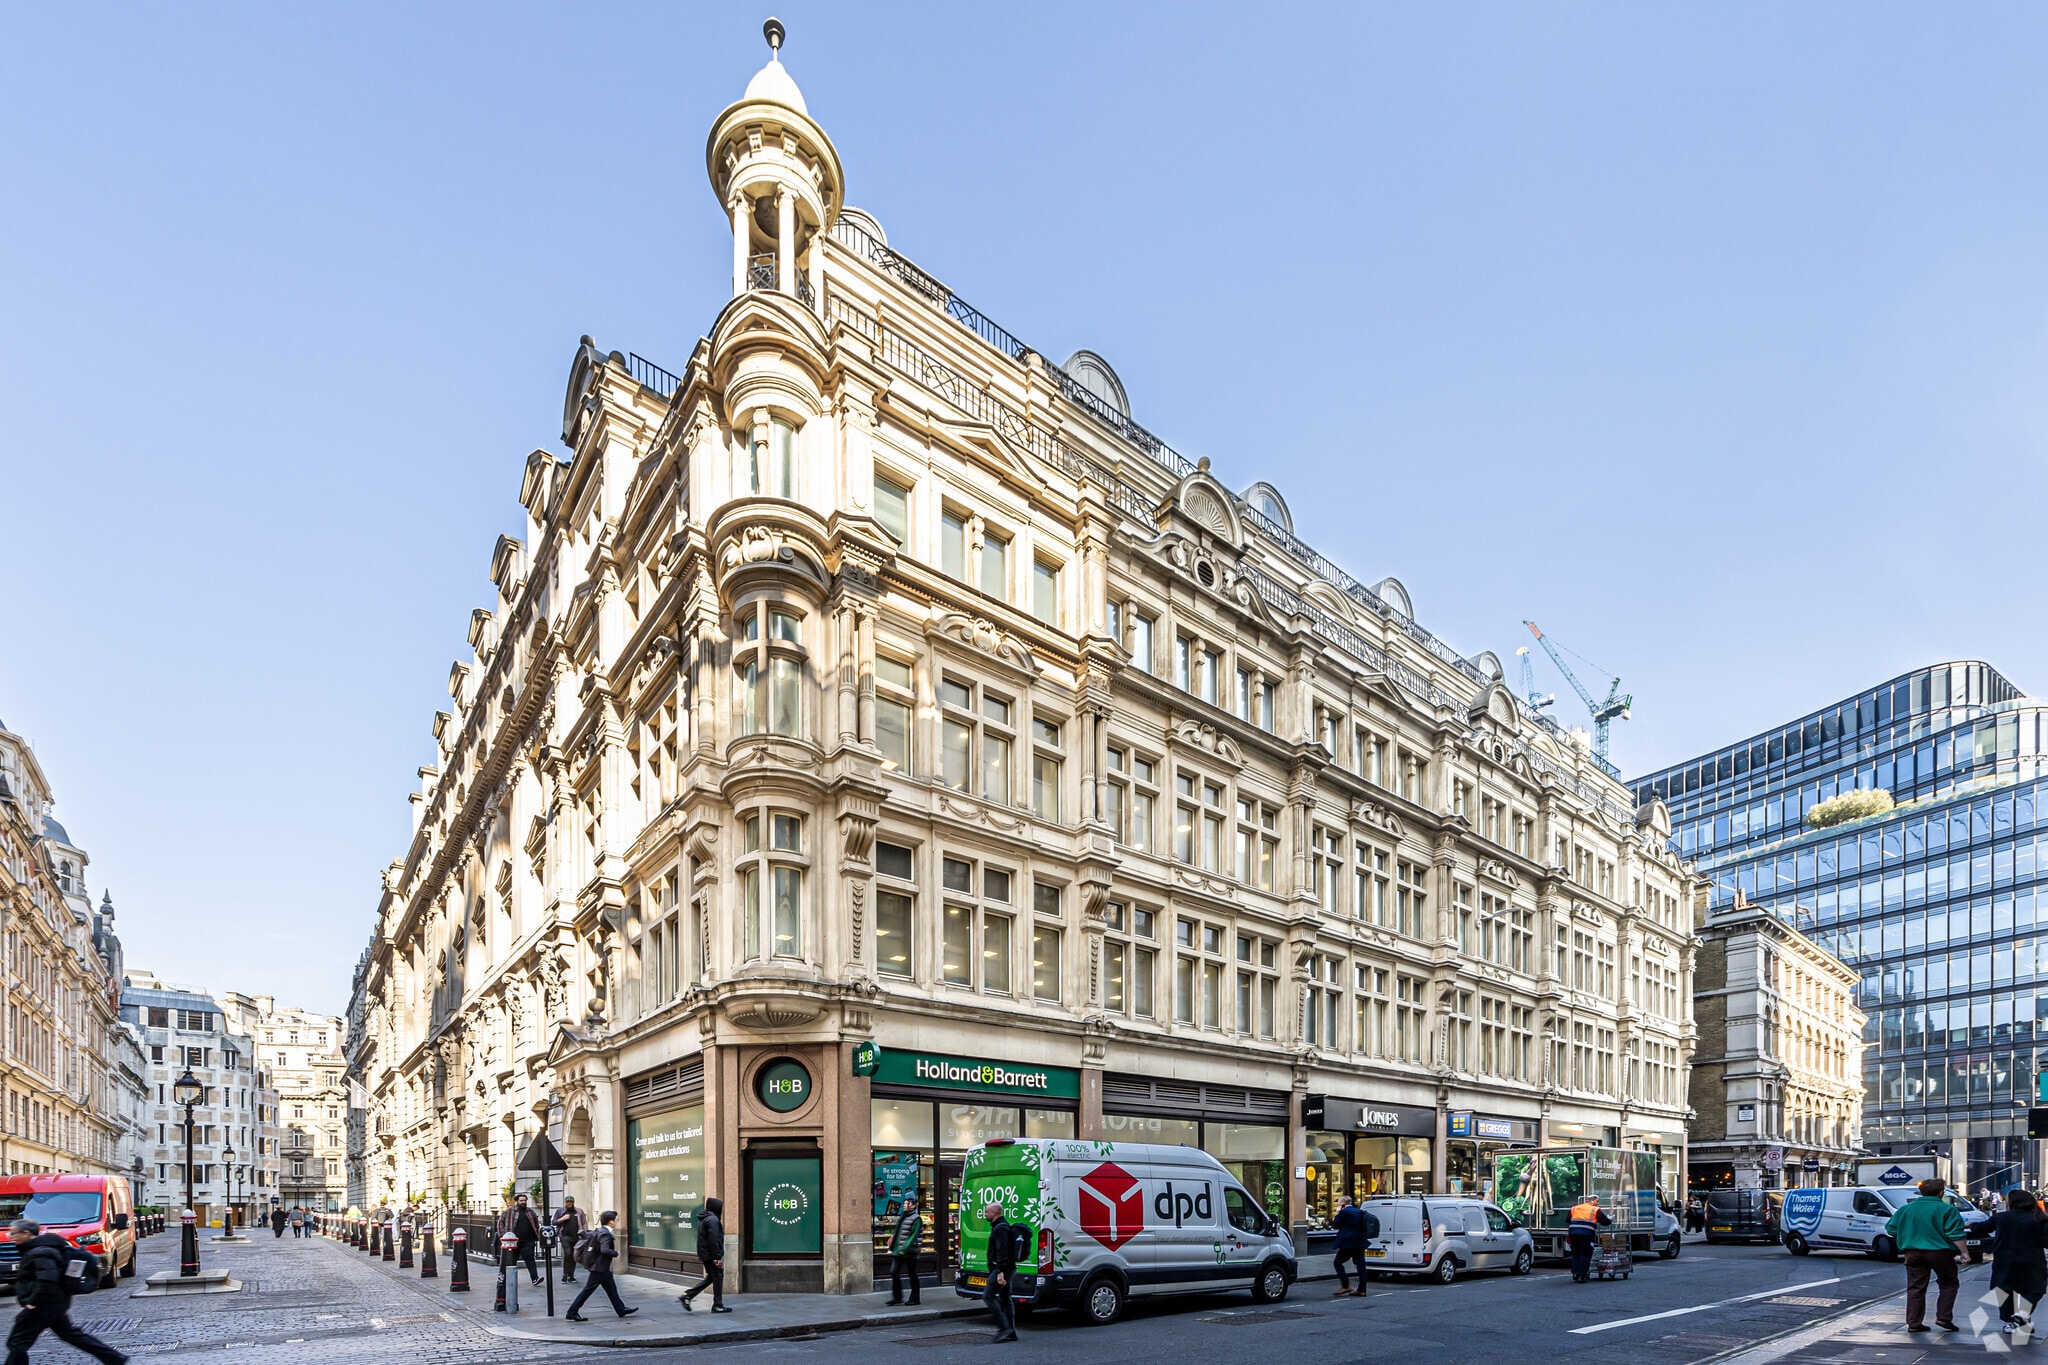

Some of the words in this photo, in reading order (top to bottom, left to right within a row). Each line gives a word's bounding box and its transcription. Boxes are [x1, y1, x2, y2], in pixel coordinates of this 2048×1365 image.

[859, 1050, 873, 1063] H&B
[769, 1079, 802, 1093] H&B
[1357, 1107, 1399, 1127] JONES
[1486, 1123, 1510, 1134] GREGGS
[636, 1137, 648, 1147] Come
[1065, 1144, 1090, 1153] 100%
[977, 1186, 1019, 1205] 100%
[1791, 1194, 1821, 1203] Thames
[774, 1199, 798, 1209] H&B
[1155, 1182, 1212, 1229] dpd
[1792, 1203, 1815, 1213] Water
[976, 1205, 1019, 1219] elric
